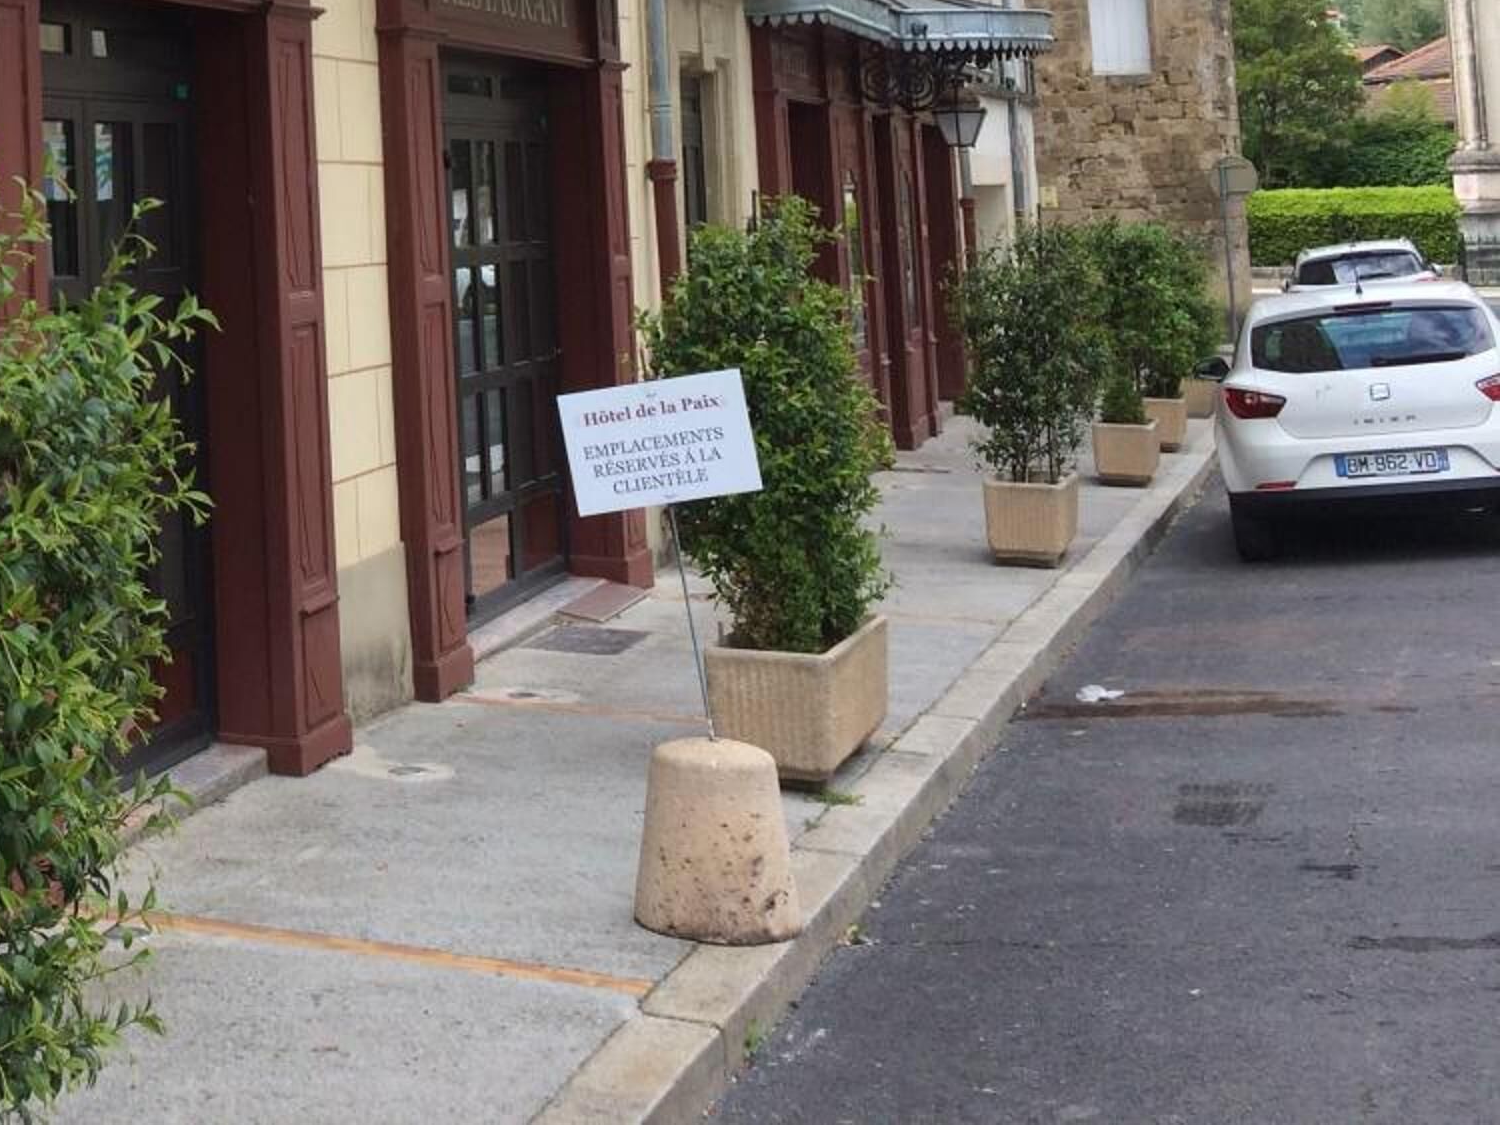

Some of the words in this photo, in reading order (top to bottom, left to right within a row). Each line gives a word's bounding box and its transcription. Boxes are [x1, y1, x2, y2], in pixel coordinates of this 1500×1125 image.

[583, 406, 631, 427] Hôtel
[635, 403, 657, 418] de
[660, 400, 677, 414] la
[681, 395, 721, 412] Paix
[583, 426, 725, 460] EMPLACEMENTS
[593, 451, 681, 478] RÉSERVÉS
[699, 446, 723, 461] LA
